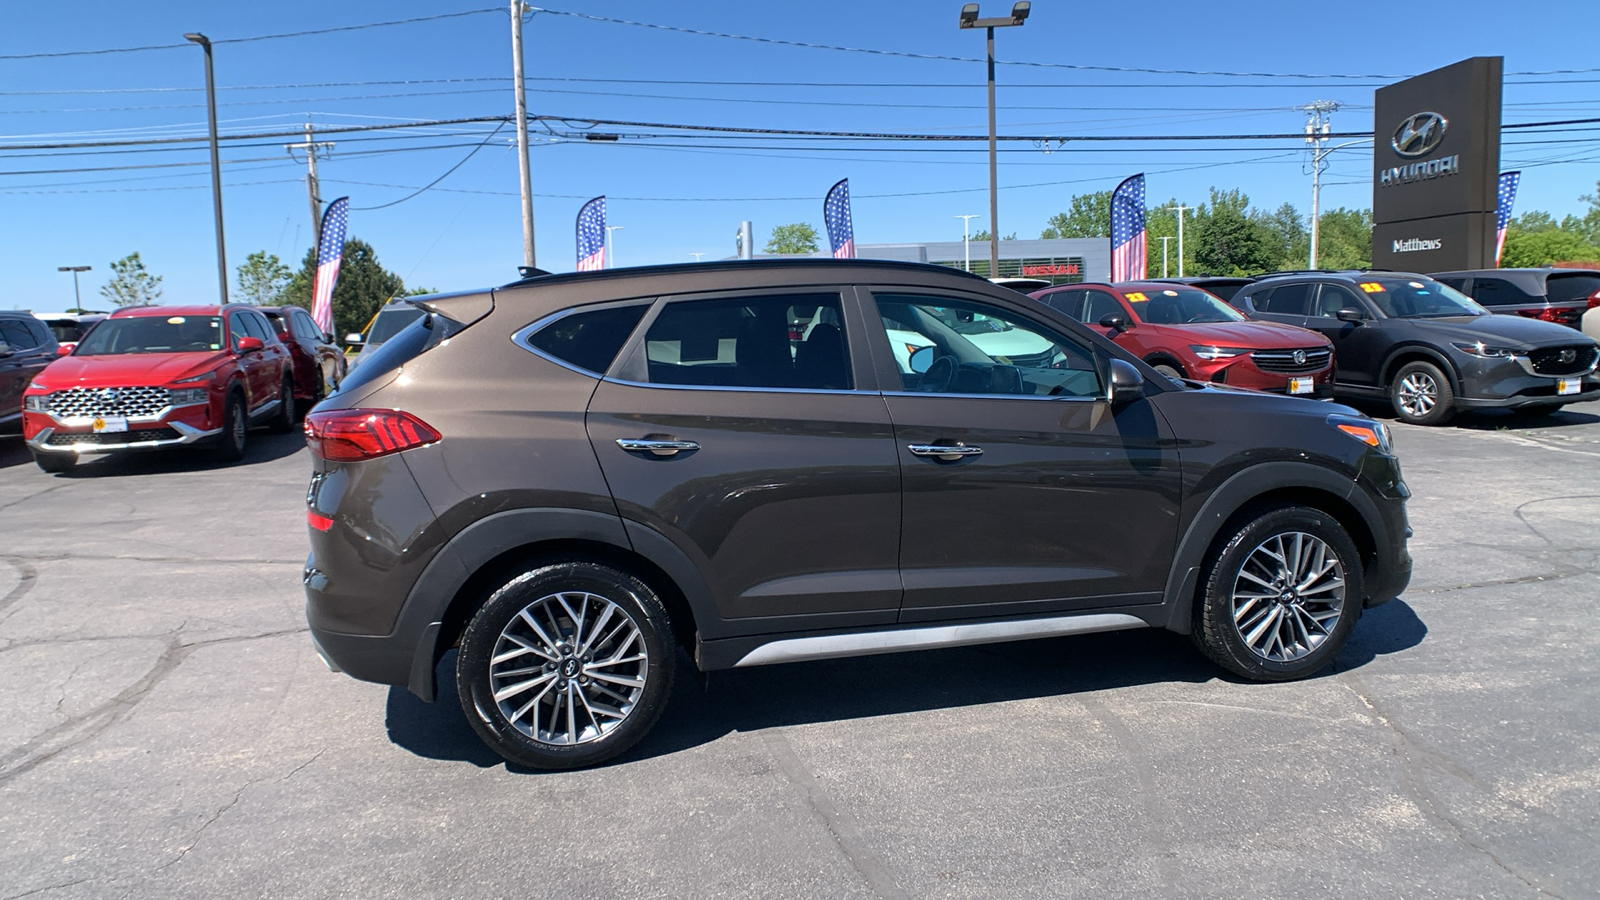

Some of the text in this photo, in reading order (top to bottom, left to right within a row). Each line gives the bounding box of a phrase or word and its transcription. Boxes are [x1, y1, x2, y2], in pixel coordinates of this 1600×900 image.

[1381, 155, 1459, 187] HYUNDAI
[1392, 238, 1442, 253] Matthews
[1023, 264, 1078, 276] NISSAN
